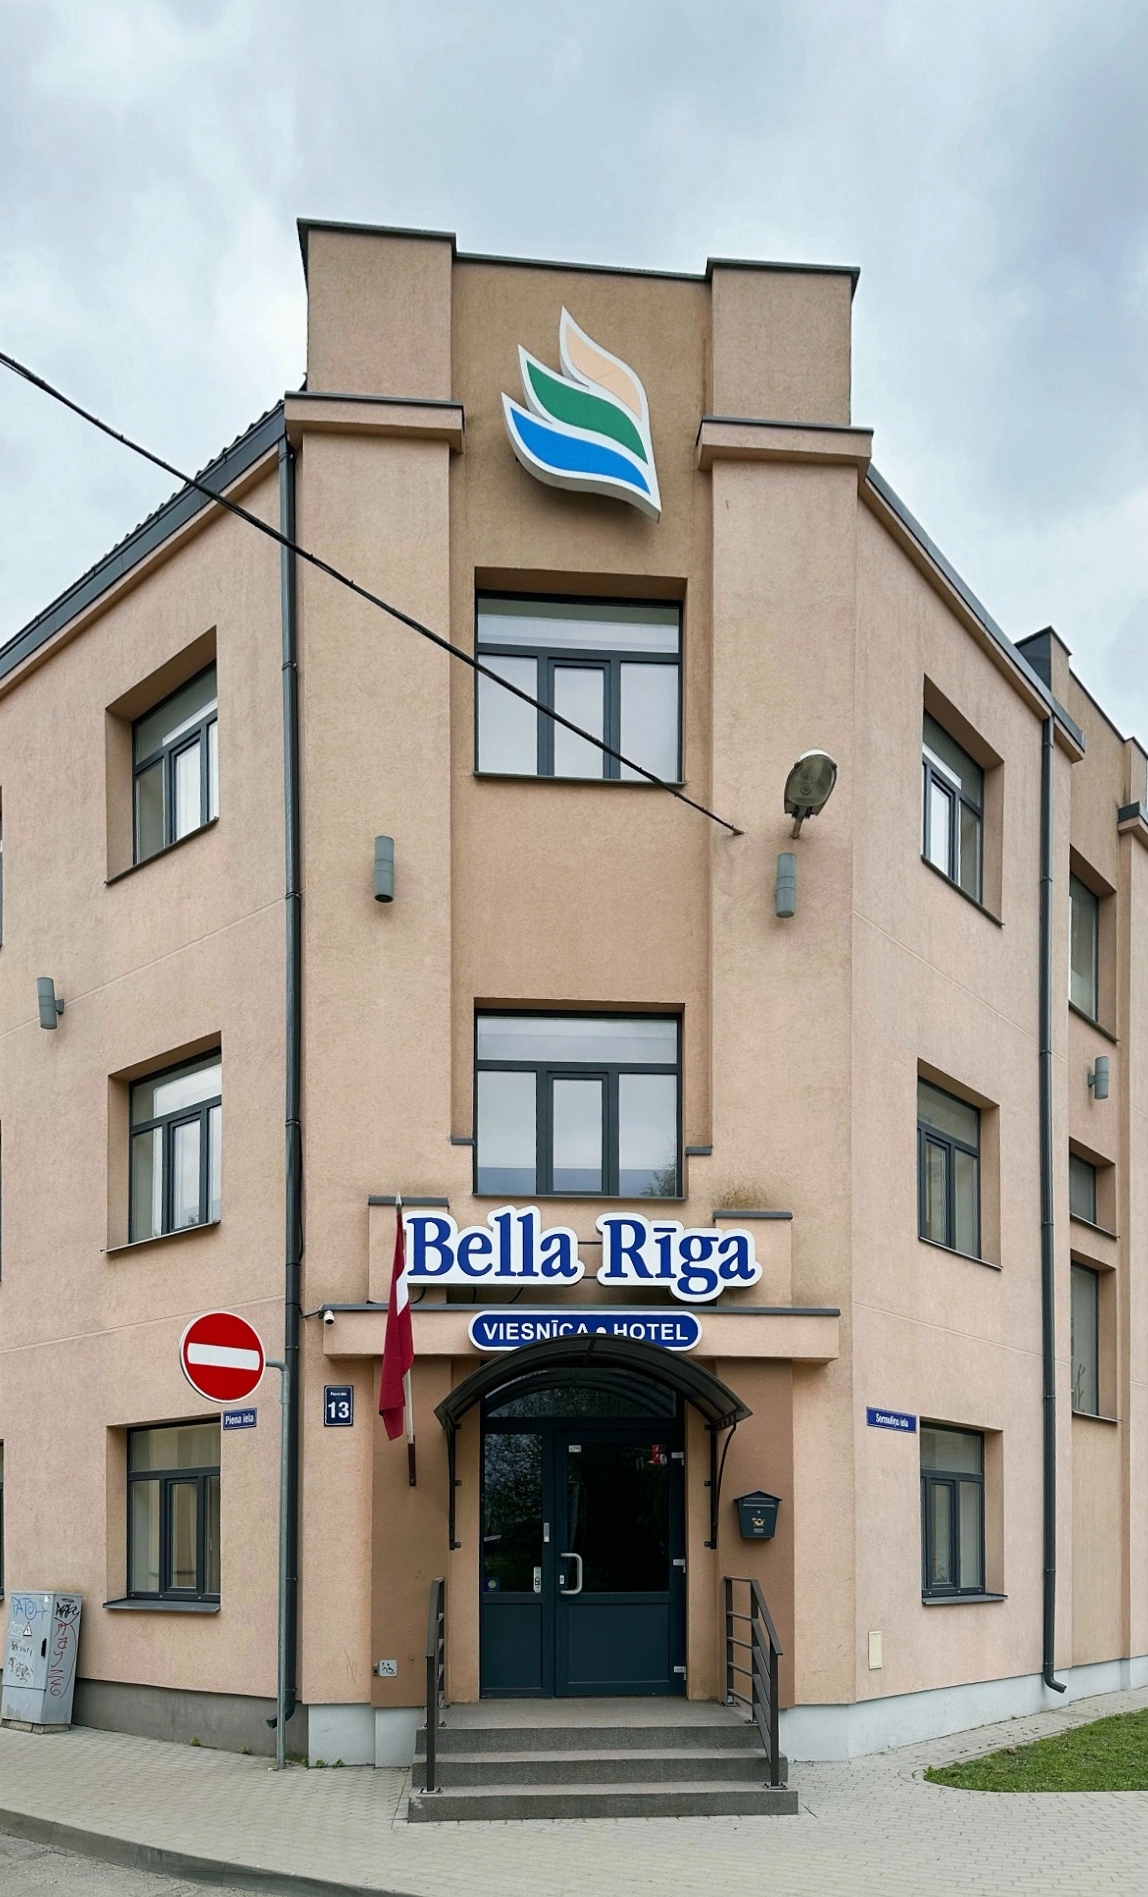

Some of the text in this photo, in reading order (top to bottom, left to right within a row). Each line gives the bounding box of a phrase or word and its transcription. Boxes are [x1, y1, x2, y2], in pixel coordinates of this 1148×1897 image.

[406, 1212, 756, 1296] Bella Rīga
[482, 1319, 689, 1341] VIESNĪCA HOTEL
[225, 1412, 254, 1426] Piena iela
[328, 1401, 350, 1419] 13
